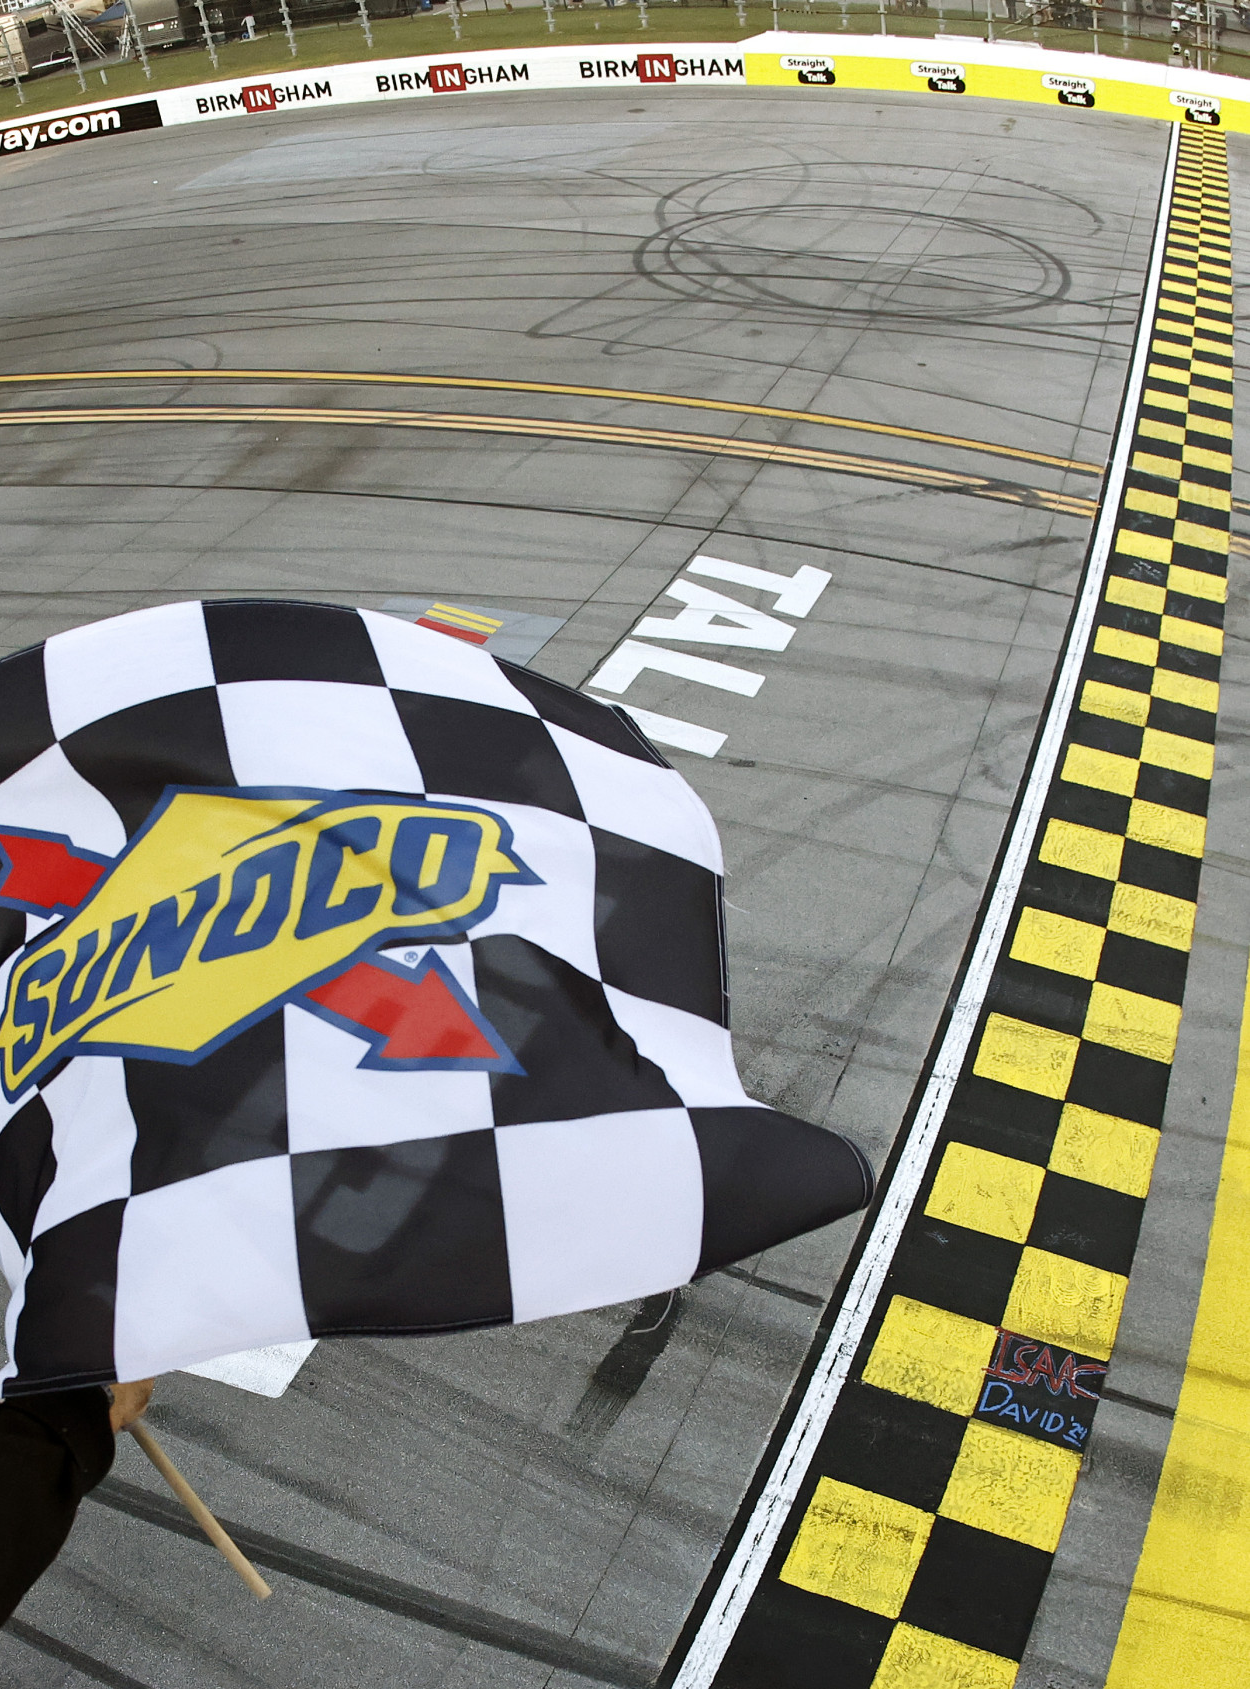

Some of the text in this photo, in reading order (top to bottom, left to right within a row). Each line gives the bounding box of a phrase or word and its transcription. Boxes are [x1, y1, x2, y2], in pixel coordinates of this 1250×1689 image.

[579, 56, 744, 81] BIRMINGHAM
[786, 57, 826, 70] Straight
[917, 63, 958, 77] Straight
[376, 63, 529, 93] BIRMINGHAM
[804, 71, 829, 84] Talk
[1048, 77, 1087, 90] Straight
[935, 79, 959, 92] Talk
[196, 80, 333, 114] BIRMINGHAM
[1066, 93, 1087, 106] Talk
[1176, 94, 1213, 108] Straight
[1191, 111, 1213, 124] Talk
[6, 815, 483, 1078] SUNOCO
[981, 1325, 1107, 1399] ISAAC
[979, 1380, 1064, 1434] DAVID
